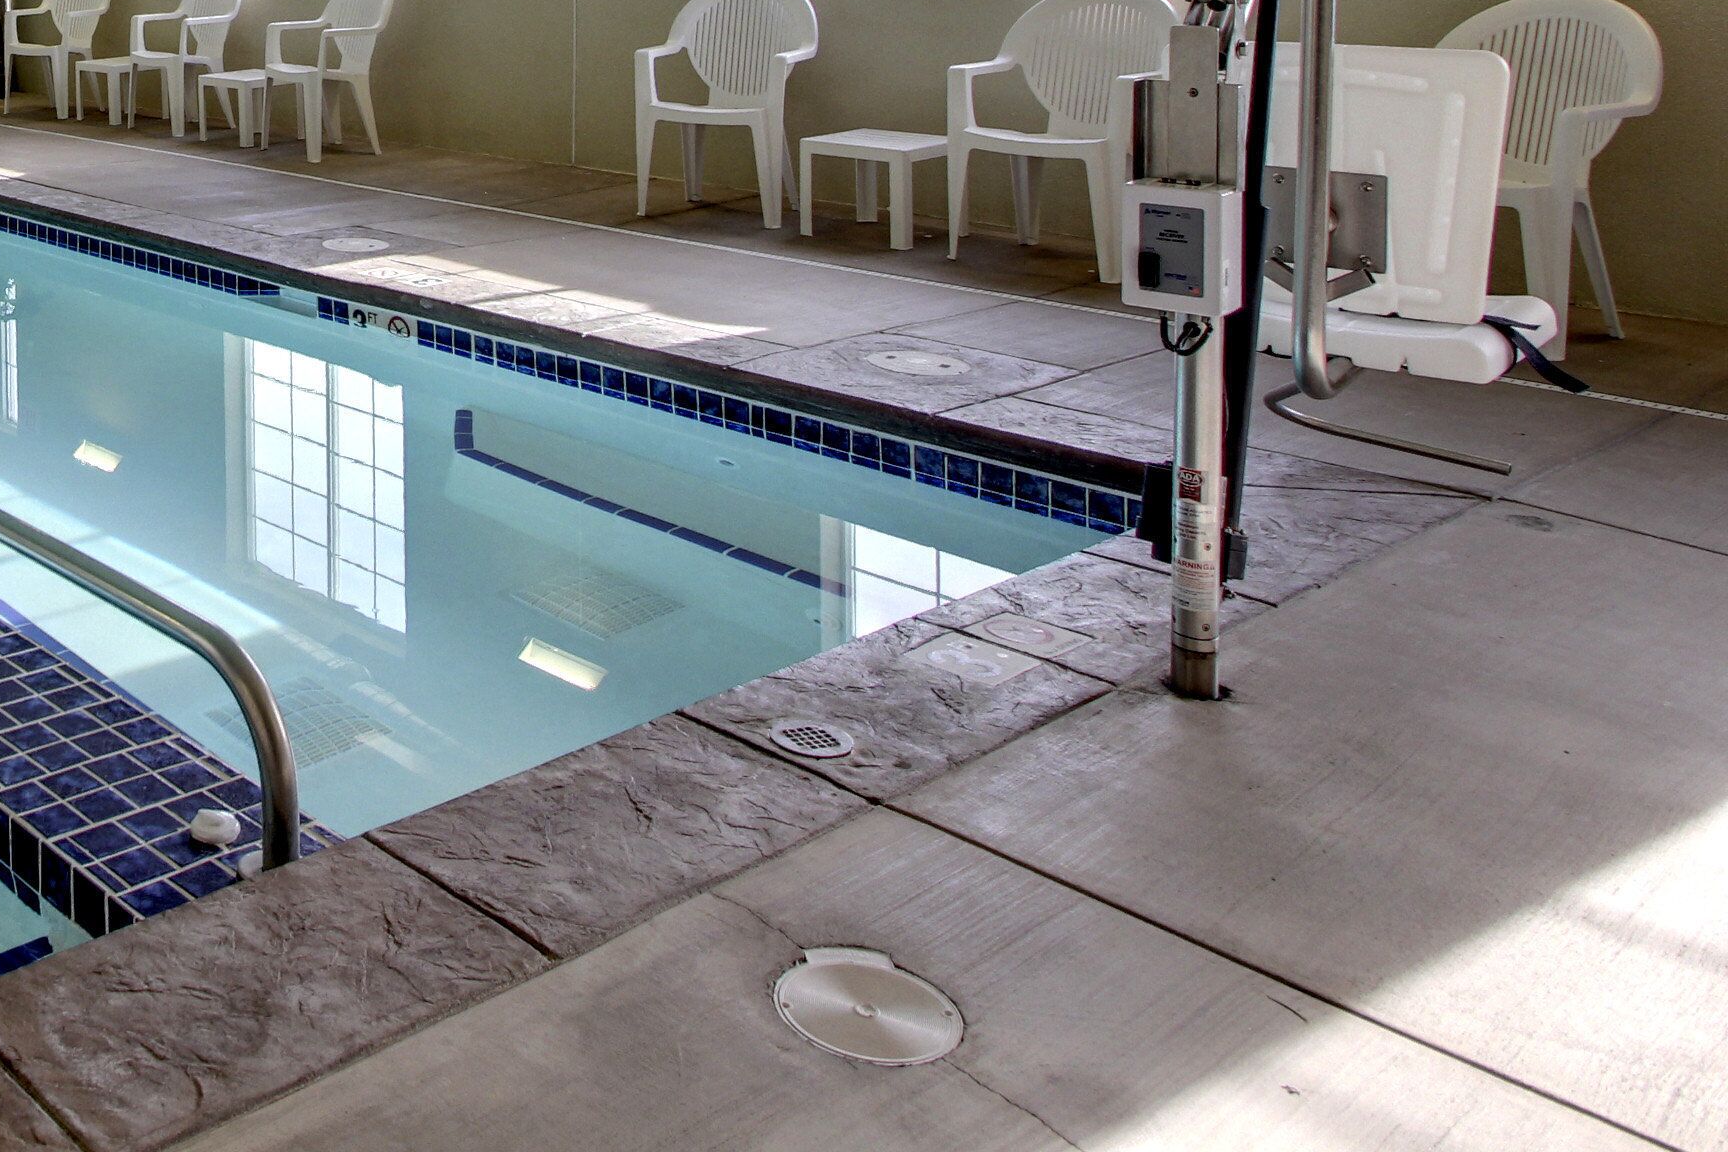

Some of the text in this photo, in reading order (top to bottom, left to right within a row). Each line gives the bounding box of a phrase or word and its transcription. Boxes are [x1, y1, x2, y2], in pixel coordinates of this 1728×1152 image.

[368, 312, 378, 324] FT
[1179, 472, 1200, 482] ADA
[1175, 559, 1209, 570] ARNING
